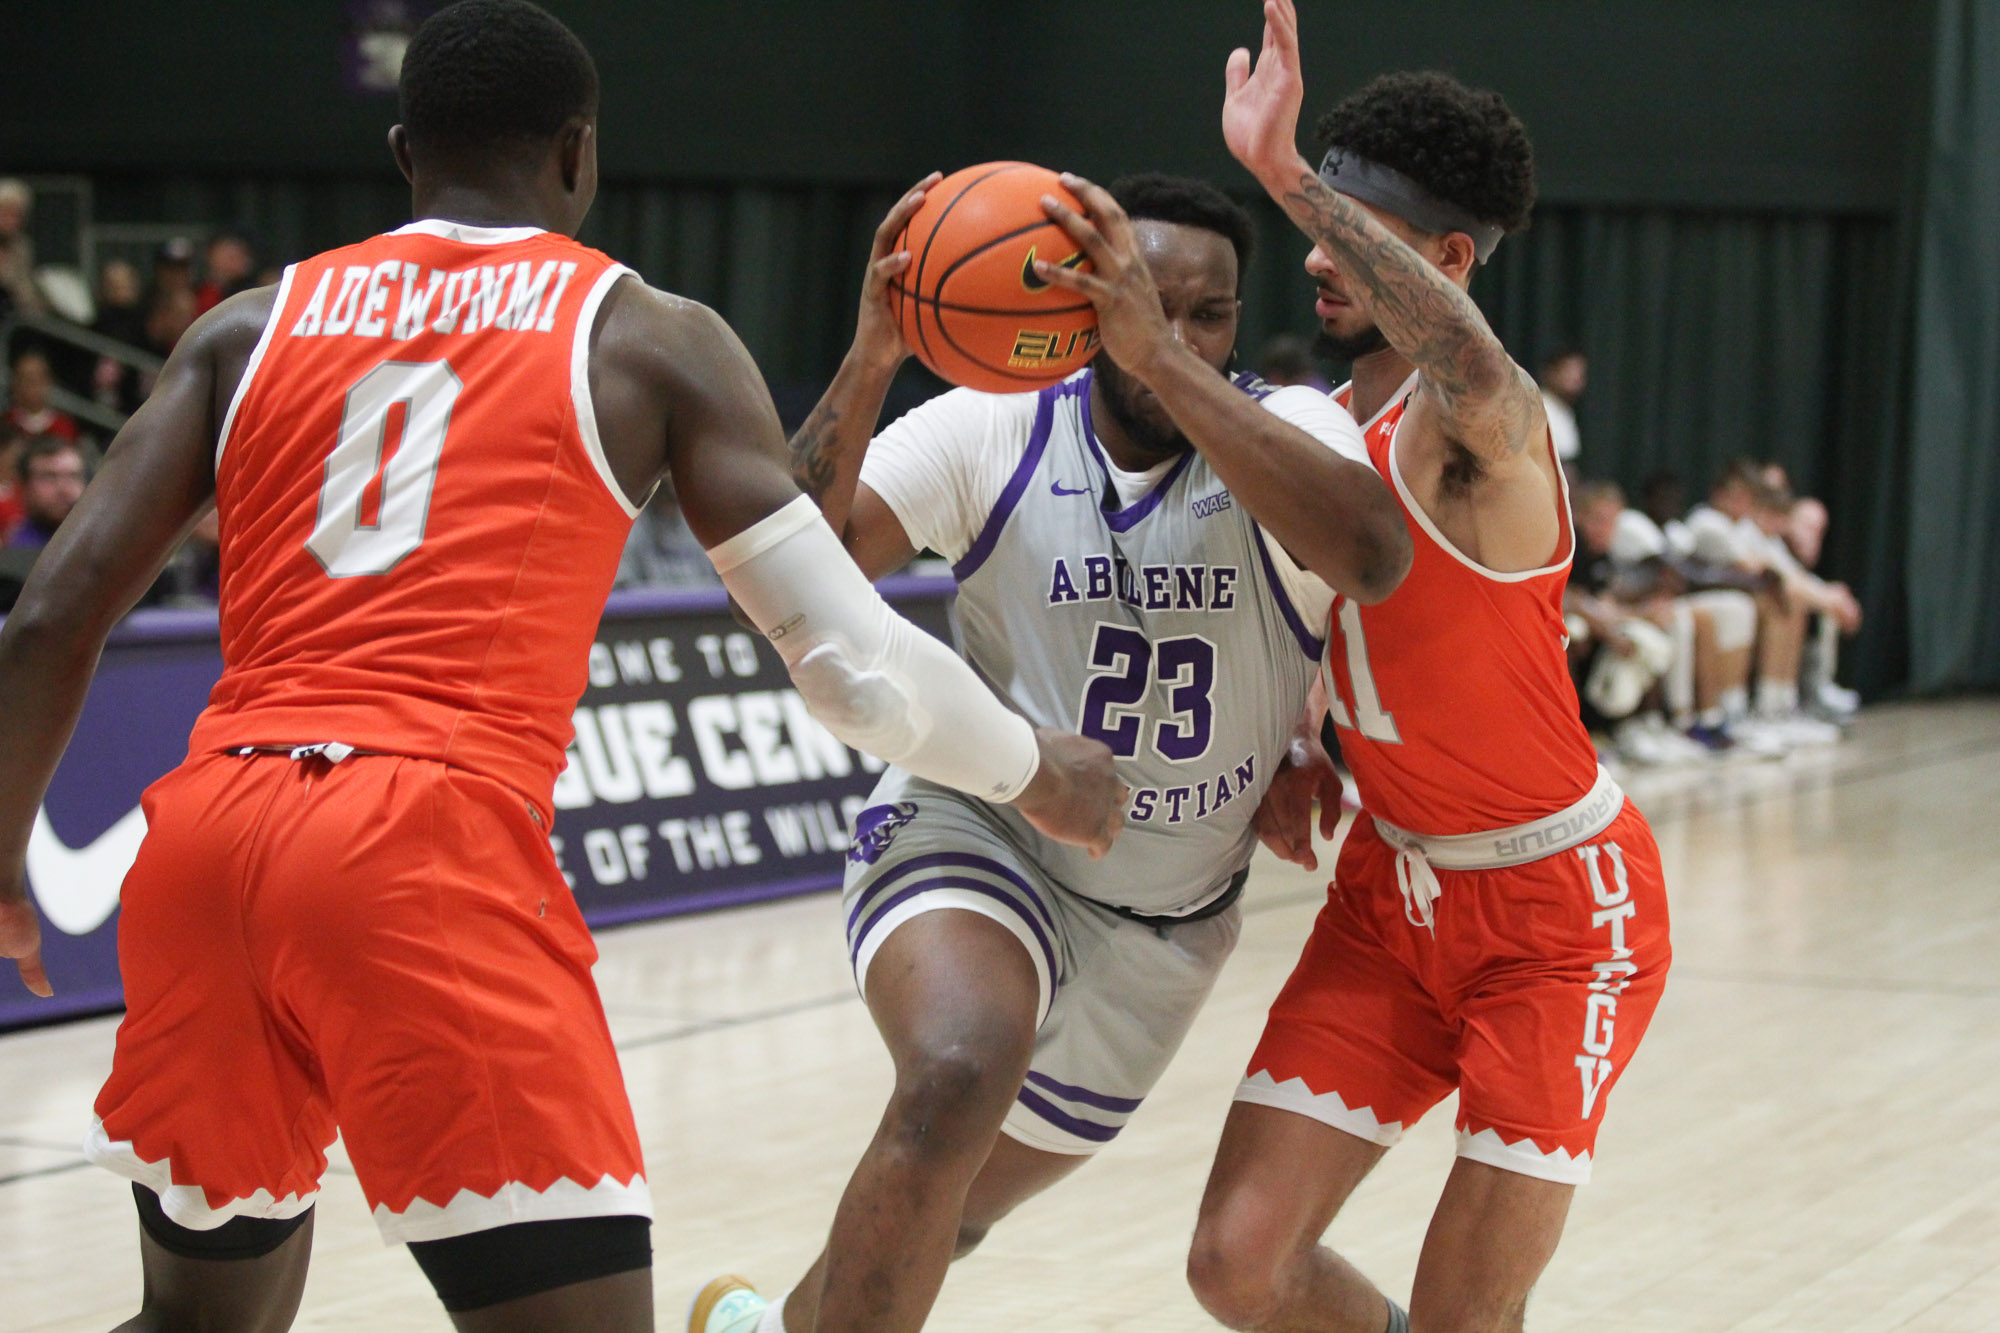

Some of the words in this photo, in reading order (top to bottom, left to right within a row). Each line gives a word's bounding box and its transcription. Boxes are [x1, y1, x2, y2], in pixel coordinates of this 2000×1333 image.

[290, 260, 578, 341] ADEWUNMI
[304, 358, 464, 579] 0
[1192, 490, 1231, 519] WAC
[695, 633, 760, 679] TO
[1077, 620, 1218, 765] 23
[687, 689, 887, 790] CEN
[1127, 754, 1256, 825] STIAN
[583, 824, 650, 885] OF
[658, 810, 763, 874] THE
[1575, 841, 1638, 1120] UTRGV
